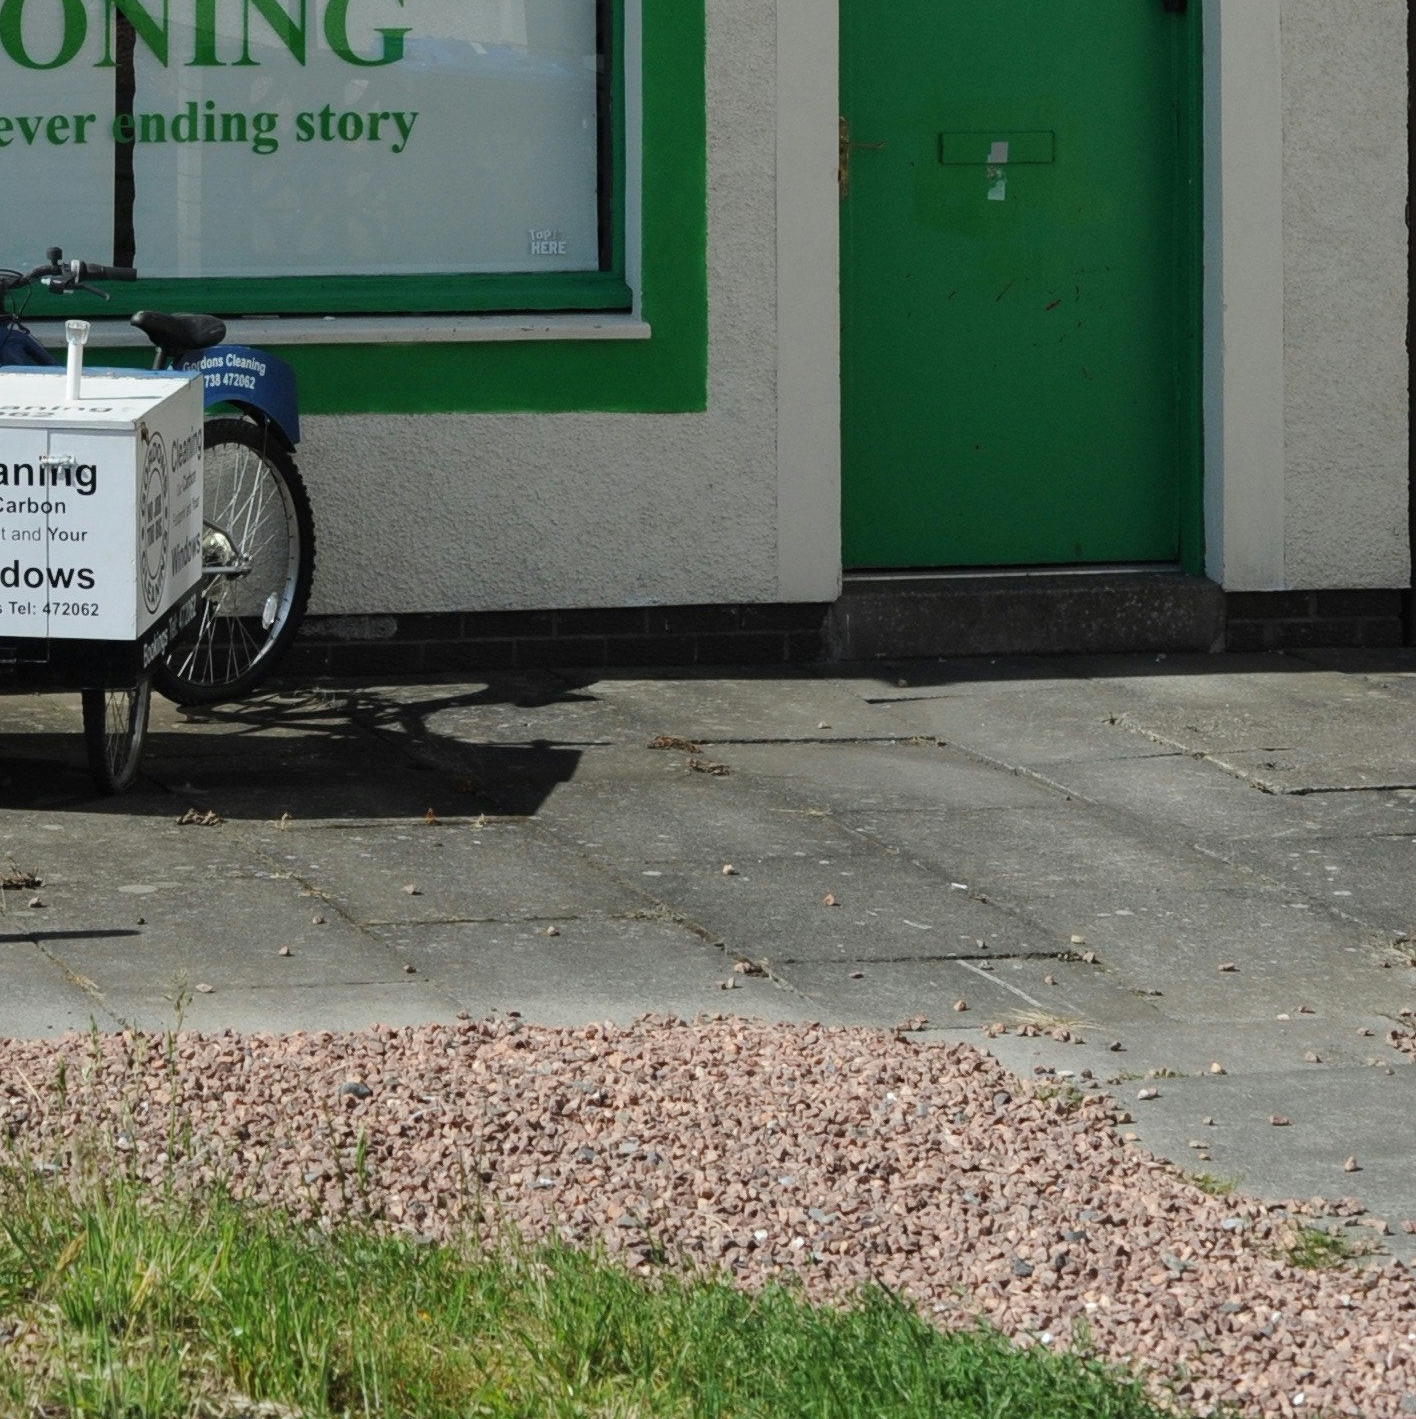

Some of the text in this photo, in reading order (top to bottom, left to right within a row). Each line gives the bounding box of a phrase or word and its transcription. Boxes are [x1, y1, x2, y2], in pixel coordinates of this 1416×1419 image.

[109, 98, 279, 156] ending
[293, 101, 420, 155] story
[531, 241, 566, 255] HERE
[225, 353, 266, 376] Cleaning
[204, 372, 256, 390] 738 472062
[11, 527, 41, 542] and
[47, 527, 88, 542] Your
[8, 601, 37, 615] Tel:
[42, 602, 100, 617] 472062
